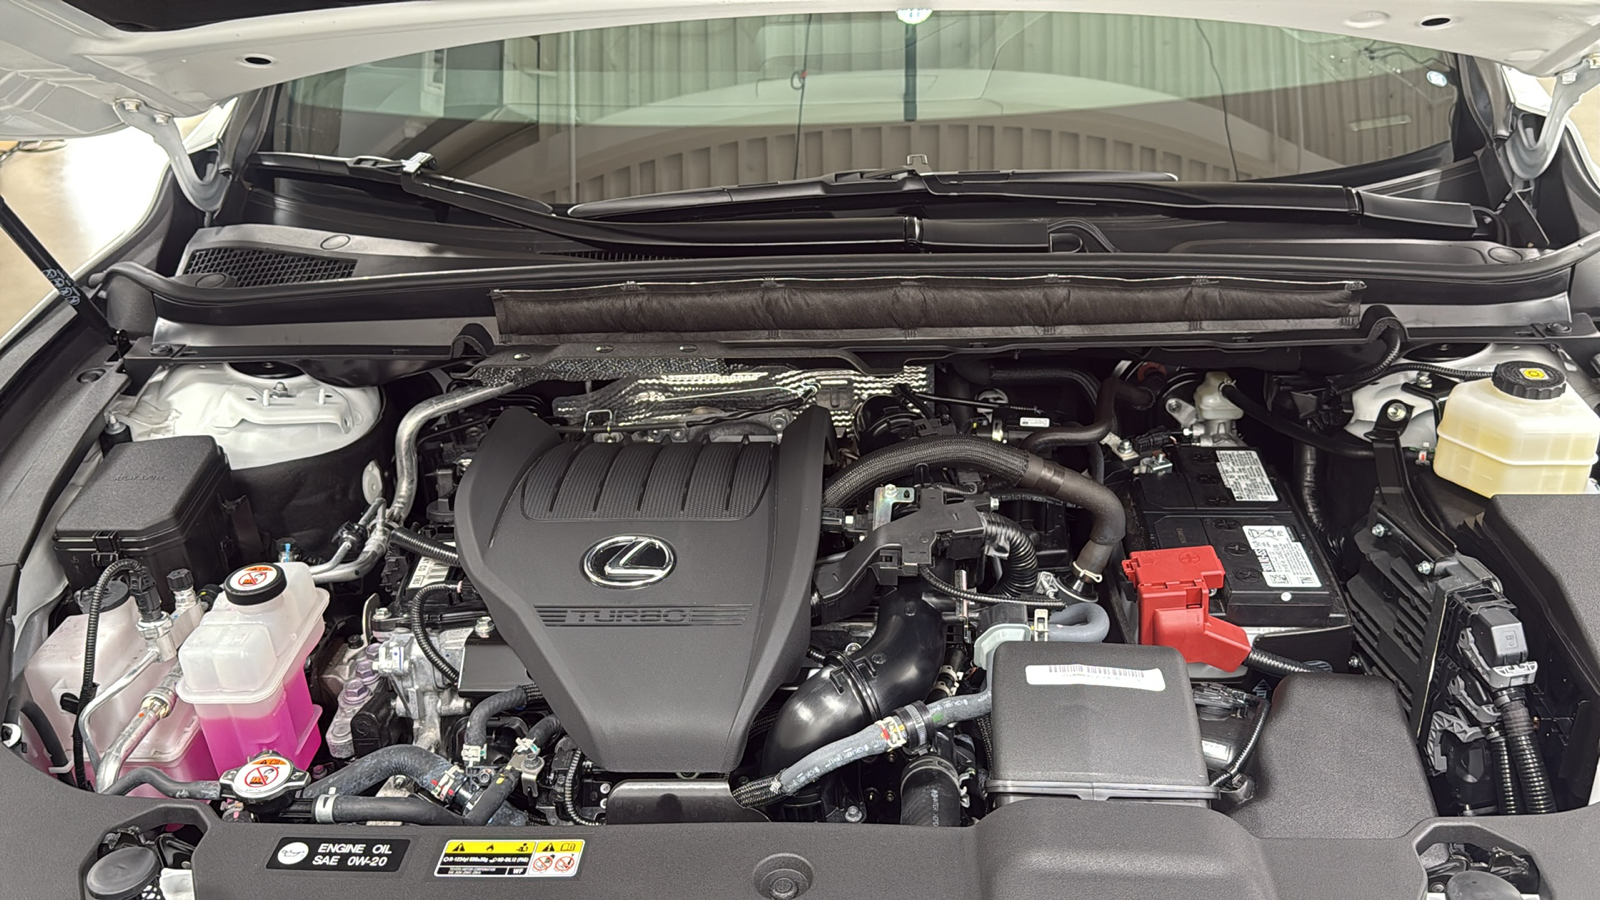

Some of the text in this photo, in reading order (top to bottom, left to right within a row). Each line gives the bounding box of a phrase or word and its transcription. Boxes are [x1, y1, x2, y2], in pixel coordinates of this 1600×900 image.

[570, 608, 687, 623] TURBO
[318, 843, 393, 854] ENGINE OIL
[312, 855, 387, 866] SAE 0W-20
